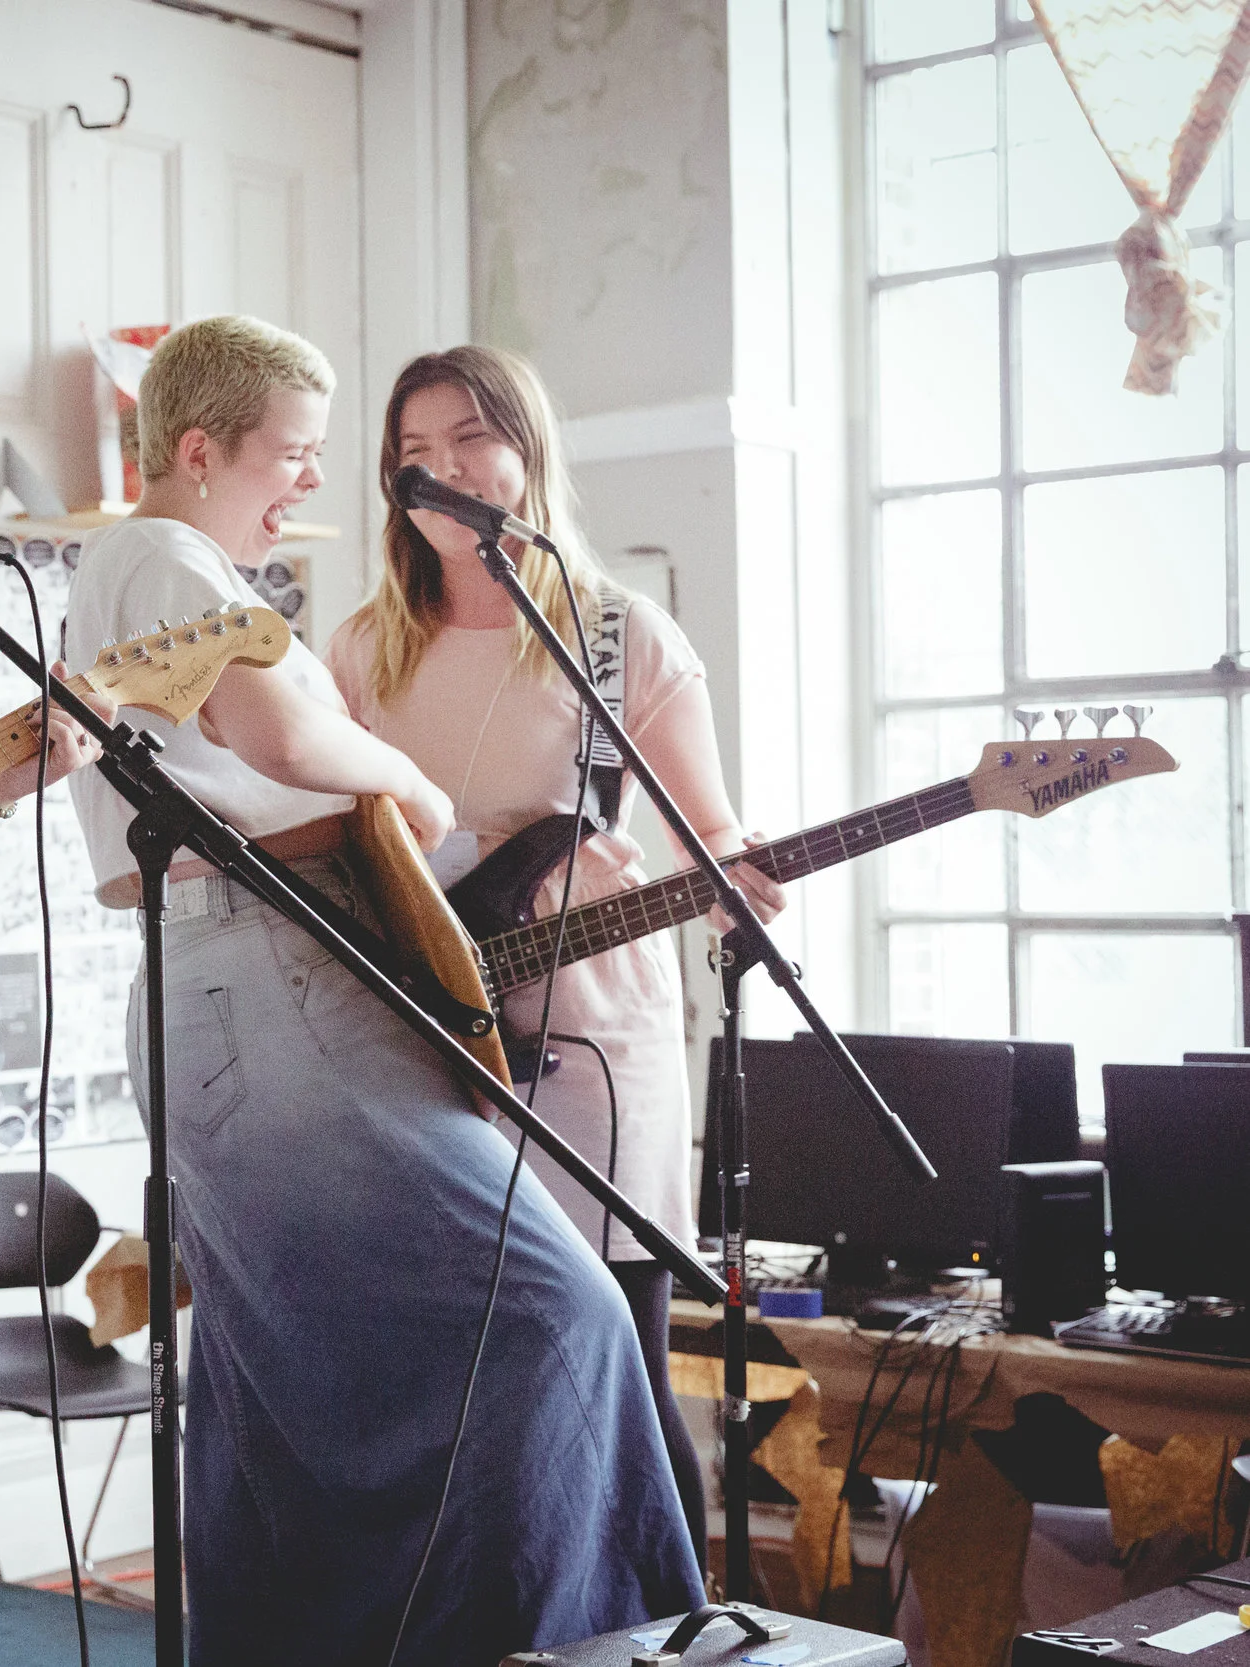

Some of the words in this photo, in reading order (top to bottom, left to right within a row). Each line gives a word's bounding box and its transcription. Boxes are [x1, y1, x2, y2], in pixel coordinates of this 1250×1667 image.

[1030, 759, 1109, 811] YAMAHA
[152, 1363, 164, 1395] Stage
[153, 1396, 165, 1434] Stands
